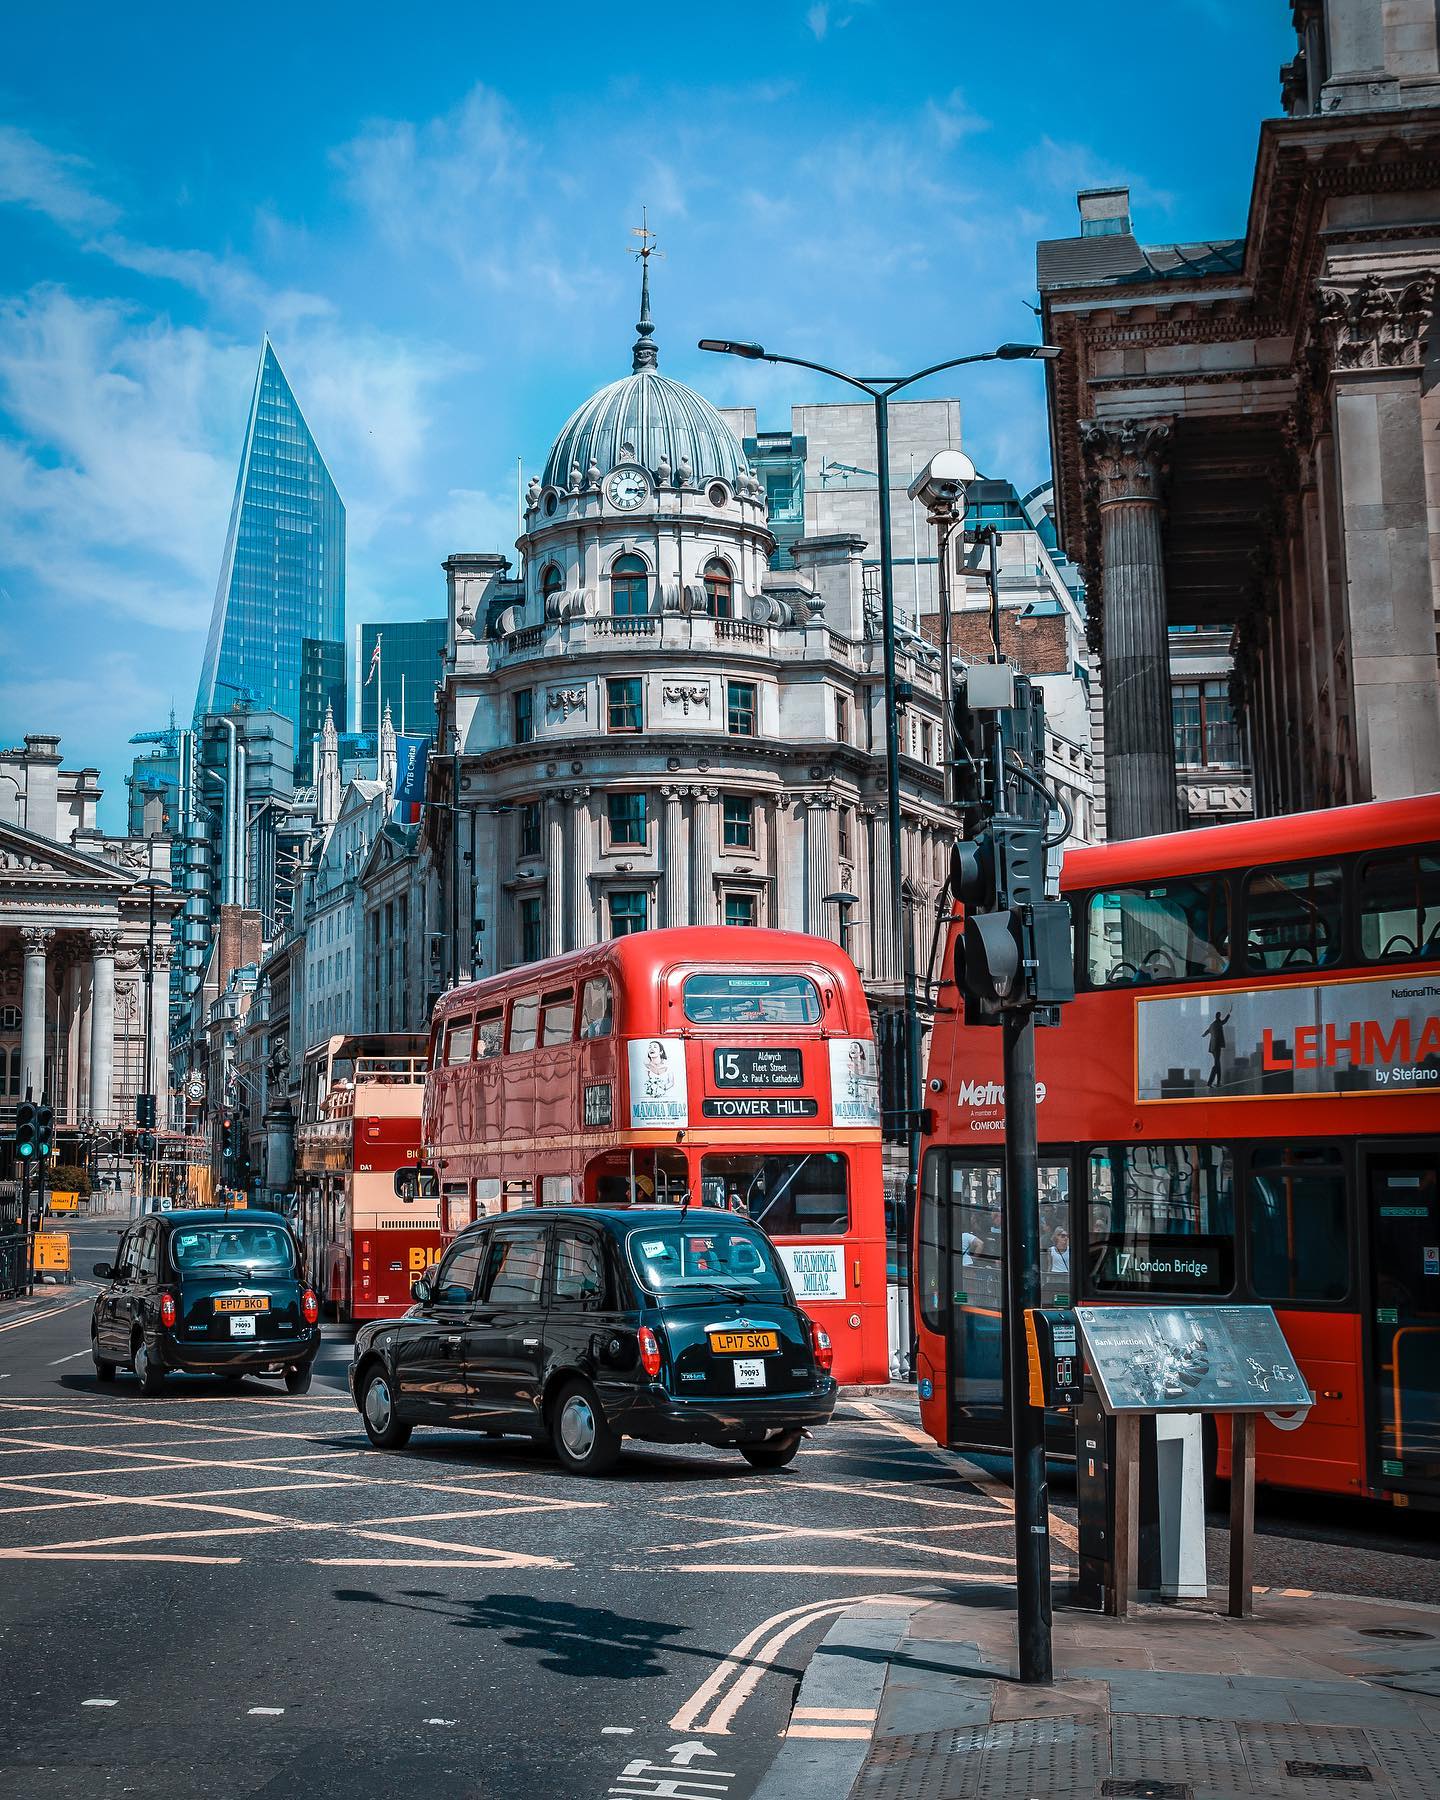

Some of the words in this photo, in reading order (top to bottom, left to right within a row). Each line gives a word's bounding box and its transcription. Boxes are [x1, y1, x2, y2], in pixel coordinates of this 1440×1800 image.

[407, 745, 417, 771] Capital
[406, 771, 415, 787] VTB
[1262, 1015, 1440, 1071] LEHMA
[758, 1052, 782, 1063] Aldwych
[718, 1054, 740, 1080] 15
[752, 1063, 768, 1072] Fleet
[769, 1063, 787, 1072] Street
[741, 1074, 749, 1083] St
[751, 1074, 769, 1083] Paul's
[771, 1074, 800, 1083] Cathedral
[1375, 1068, 1389, 1084] by
[1391, 1067, 1438, 1081] Stefano
[957, 1080, 1047, 1107] Metre
[713, 1101, 771, 1115] TOWER
[776, 1100, 809, 1114] HILL
[793, 1253, 837, 1273] MAMMA
[1116, 1253, 1131, 1275] 17
[1134, 1258, 1172, 1272] London
[1174, 1259, 1208, 1277] Bridge
[803, 1273, 831, 1292] MIA!
[220, 1301, 241, 1310] EP17
[718, 1335, 743, 1349] LP17
[747, 1335, 770, 1348] SKO
[740, 1369, 760, 1377] 79093
